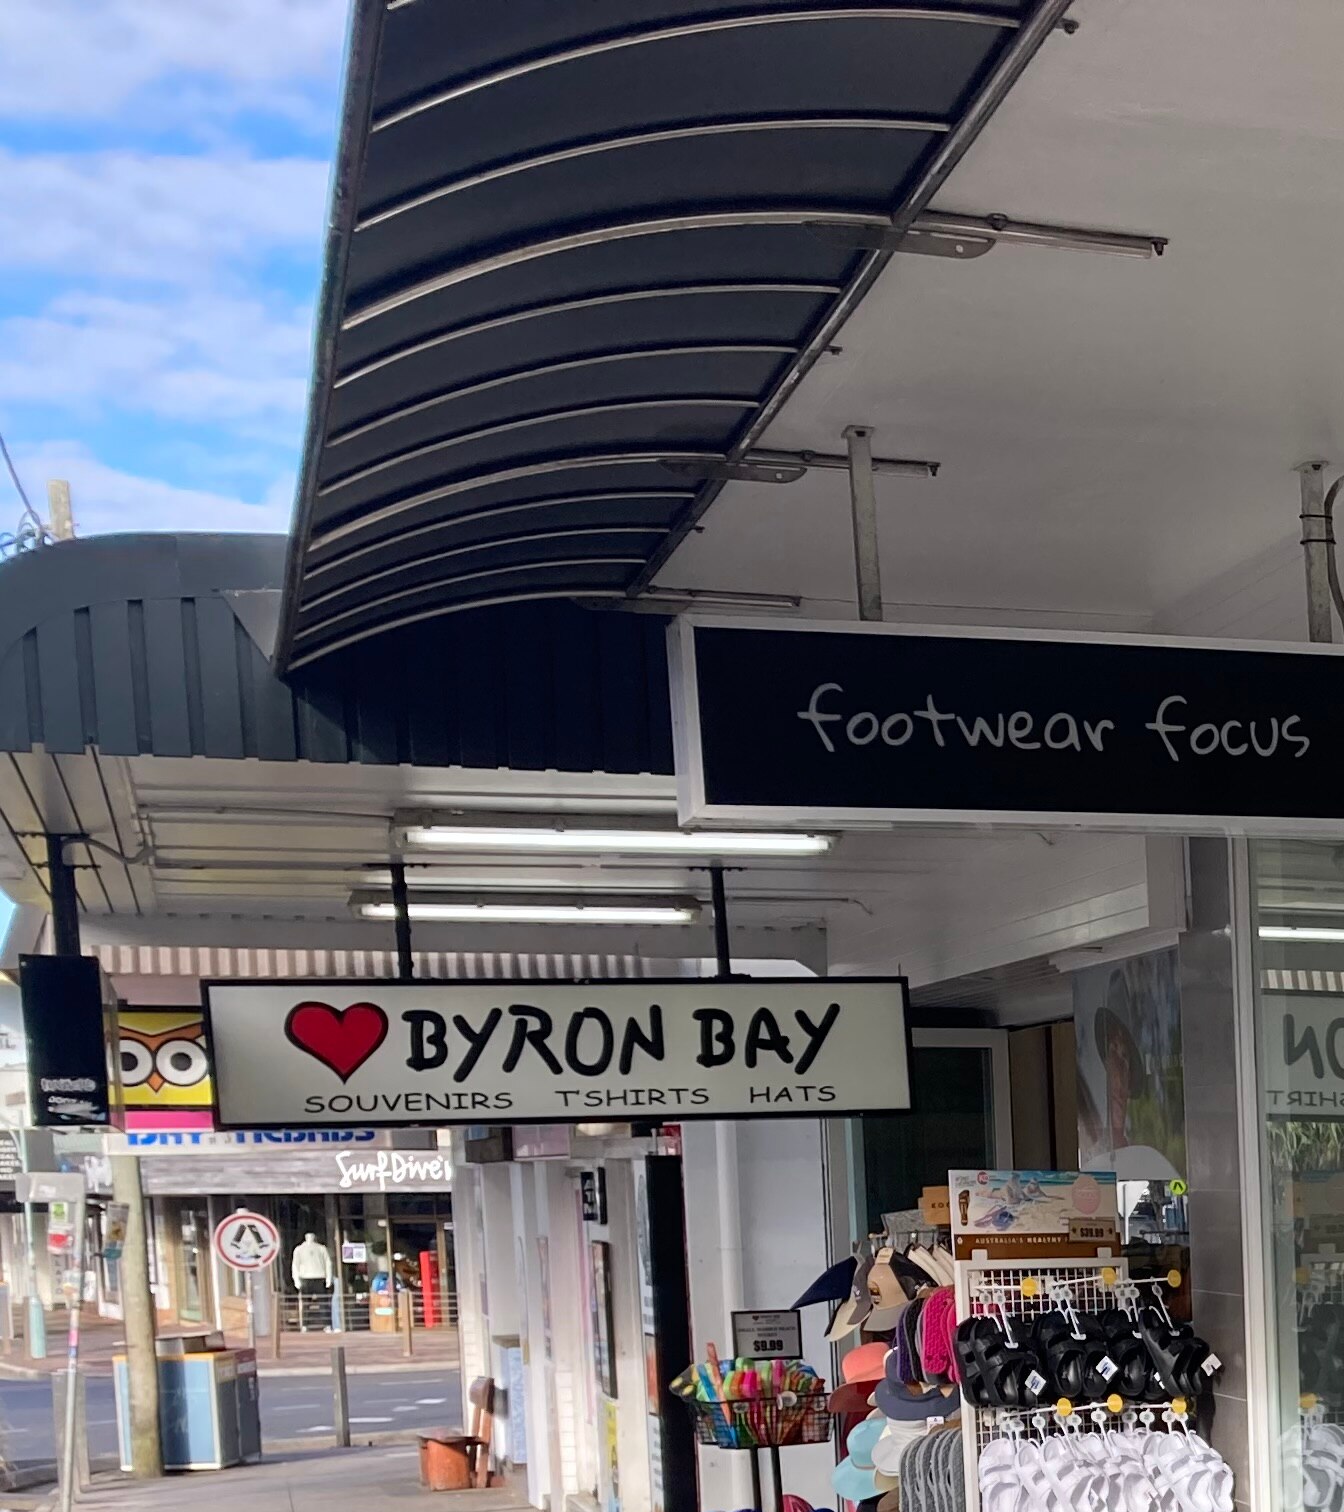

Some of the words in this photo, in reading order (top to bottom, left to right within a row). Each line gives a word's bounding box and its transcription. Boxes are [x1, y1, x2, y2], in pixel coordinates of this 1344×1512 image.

[799, 682, 1116, 754] footwear
[1145, 696, 1312, 763] focus
[401, 1004, 666, 1083] BYRON
[692, 1003, 841, 1076] BAY
[304, 1091, 514, 1114] SOUVENIRS
[749, 1085, 837, 1104] HATS
[753, 1340, 784, 1352] $9.99
